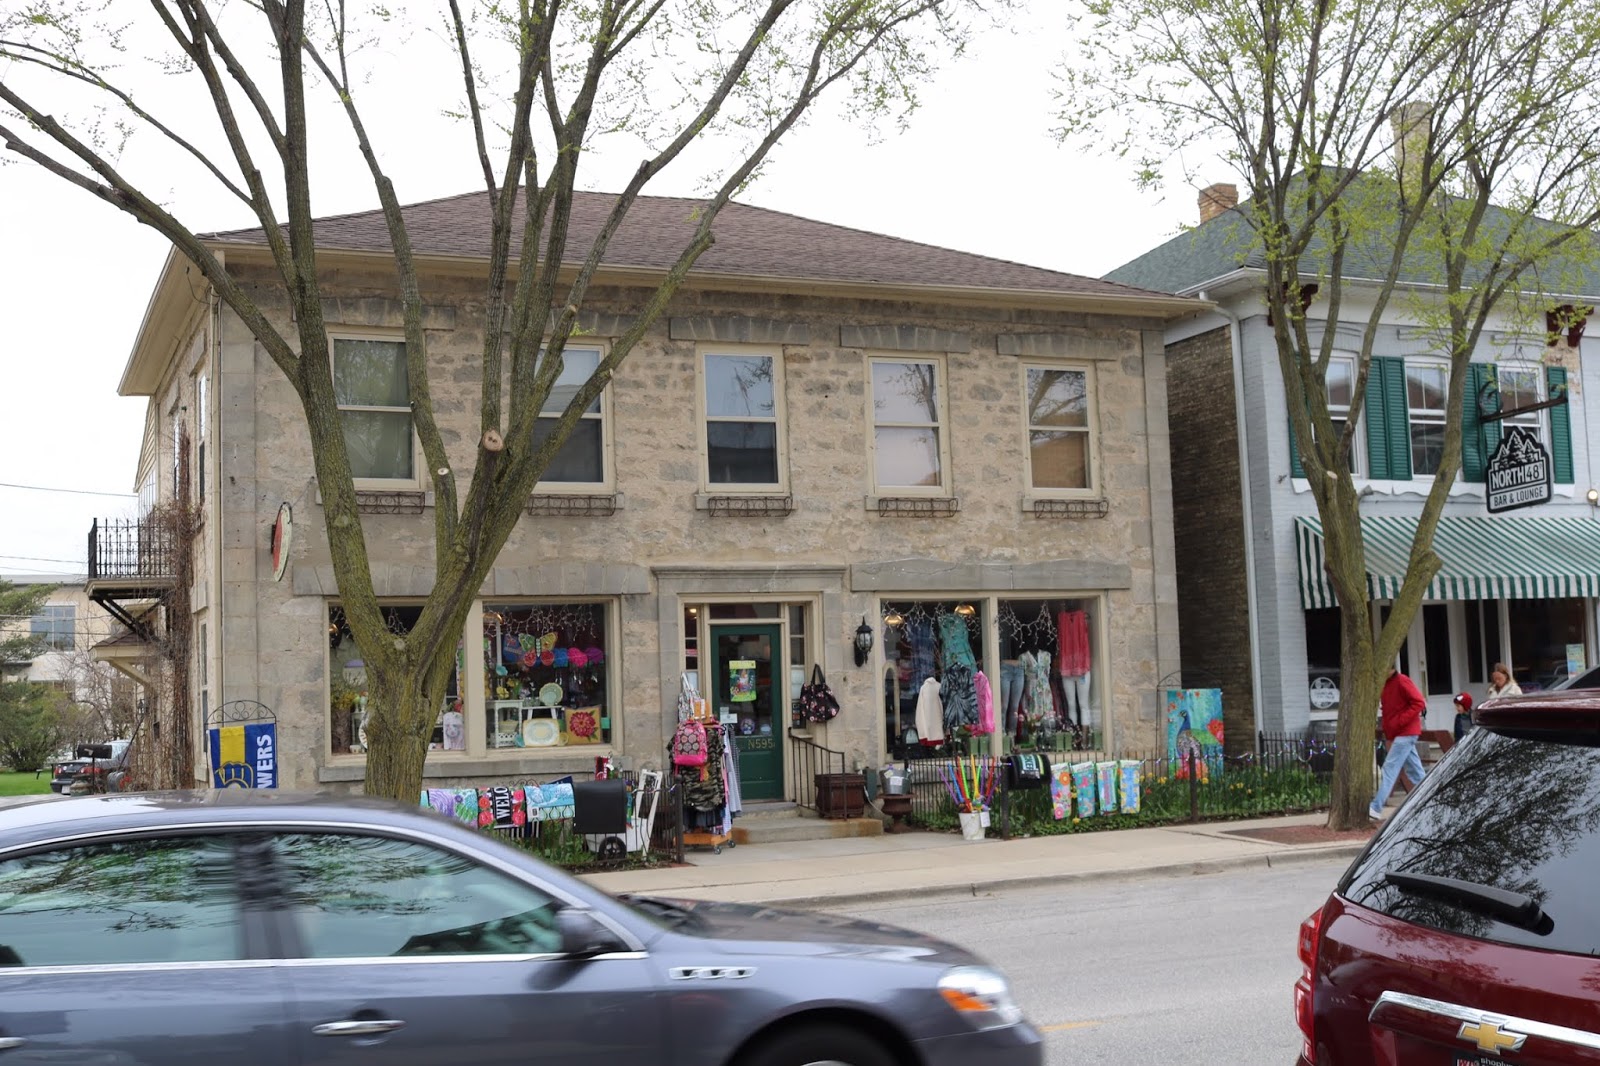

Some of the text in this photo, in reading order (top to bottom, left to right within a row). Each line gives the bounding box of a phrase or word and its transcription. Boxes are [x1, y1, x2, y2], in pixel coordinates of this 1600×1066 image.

[1491, 465, 1525, 489] NORTH
[1493, 486, 1544, 507] BAR & LOUNGE
